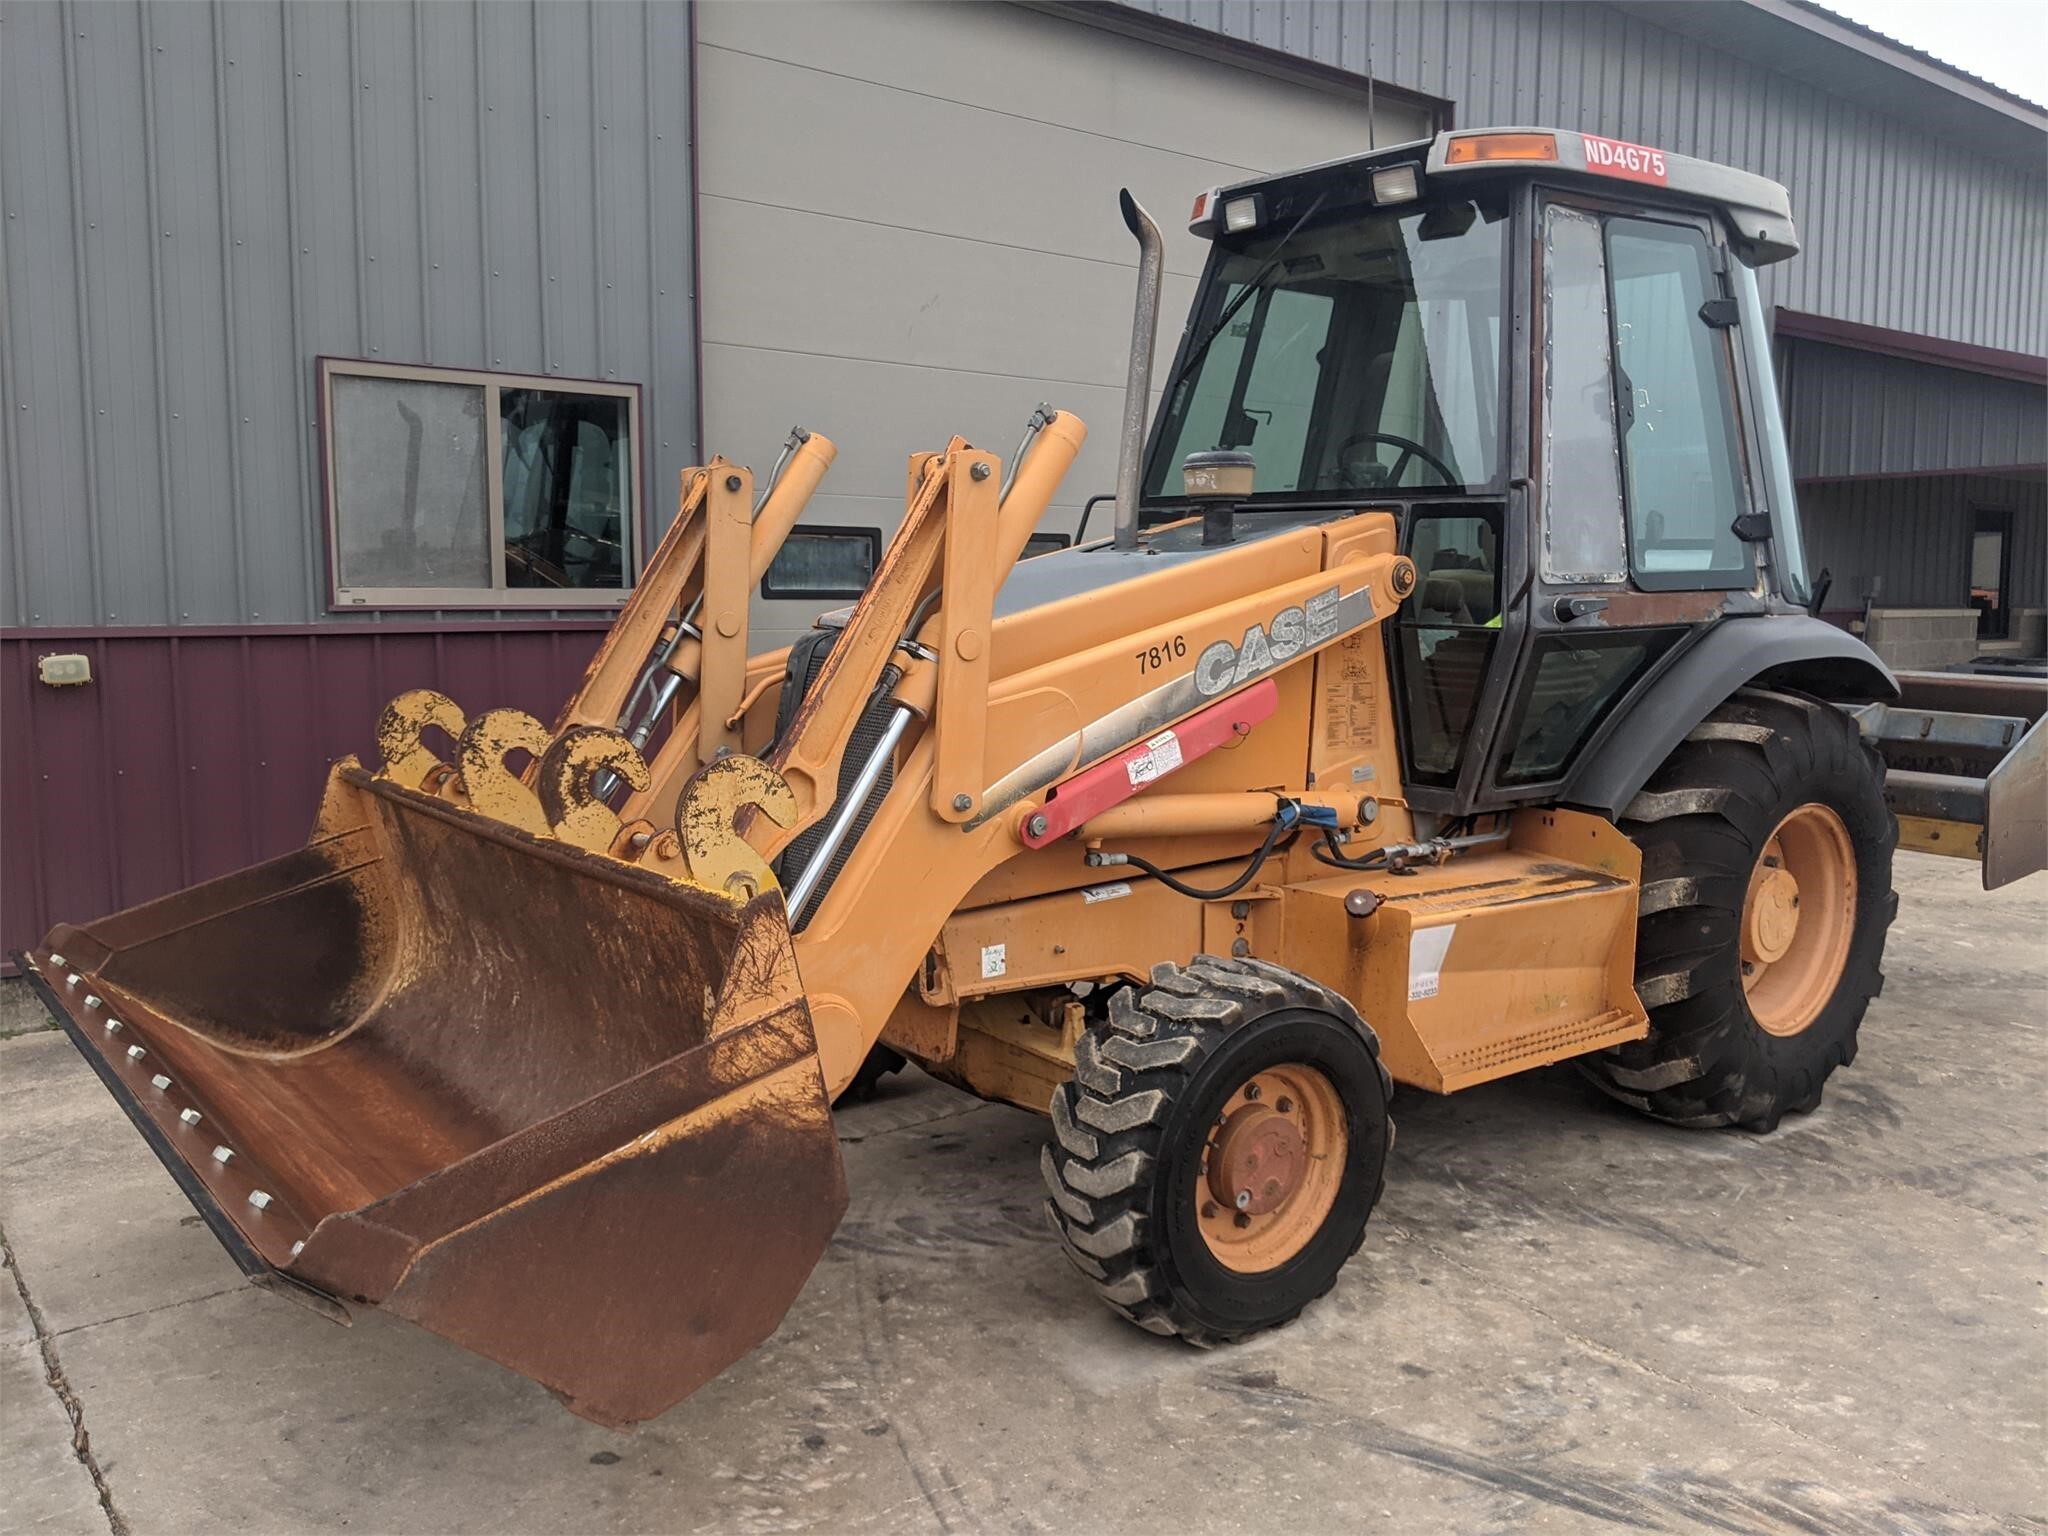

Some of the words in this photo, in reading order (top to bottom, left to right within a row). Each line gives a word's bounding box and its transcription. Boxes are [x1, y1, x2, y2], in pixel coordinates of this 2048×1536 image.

[1584, 139, 1665, 177] ND4G75
[1136, 635, 1187, 675] 7816
[1195, 585, 1339, 696] CASE
